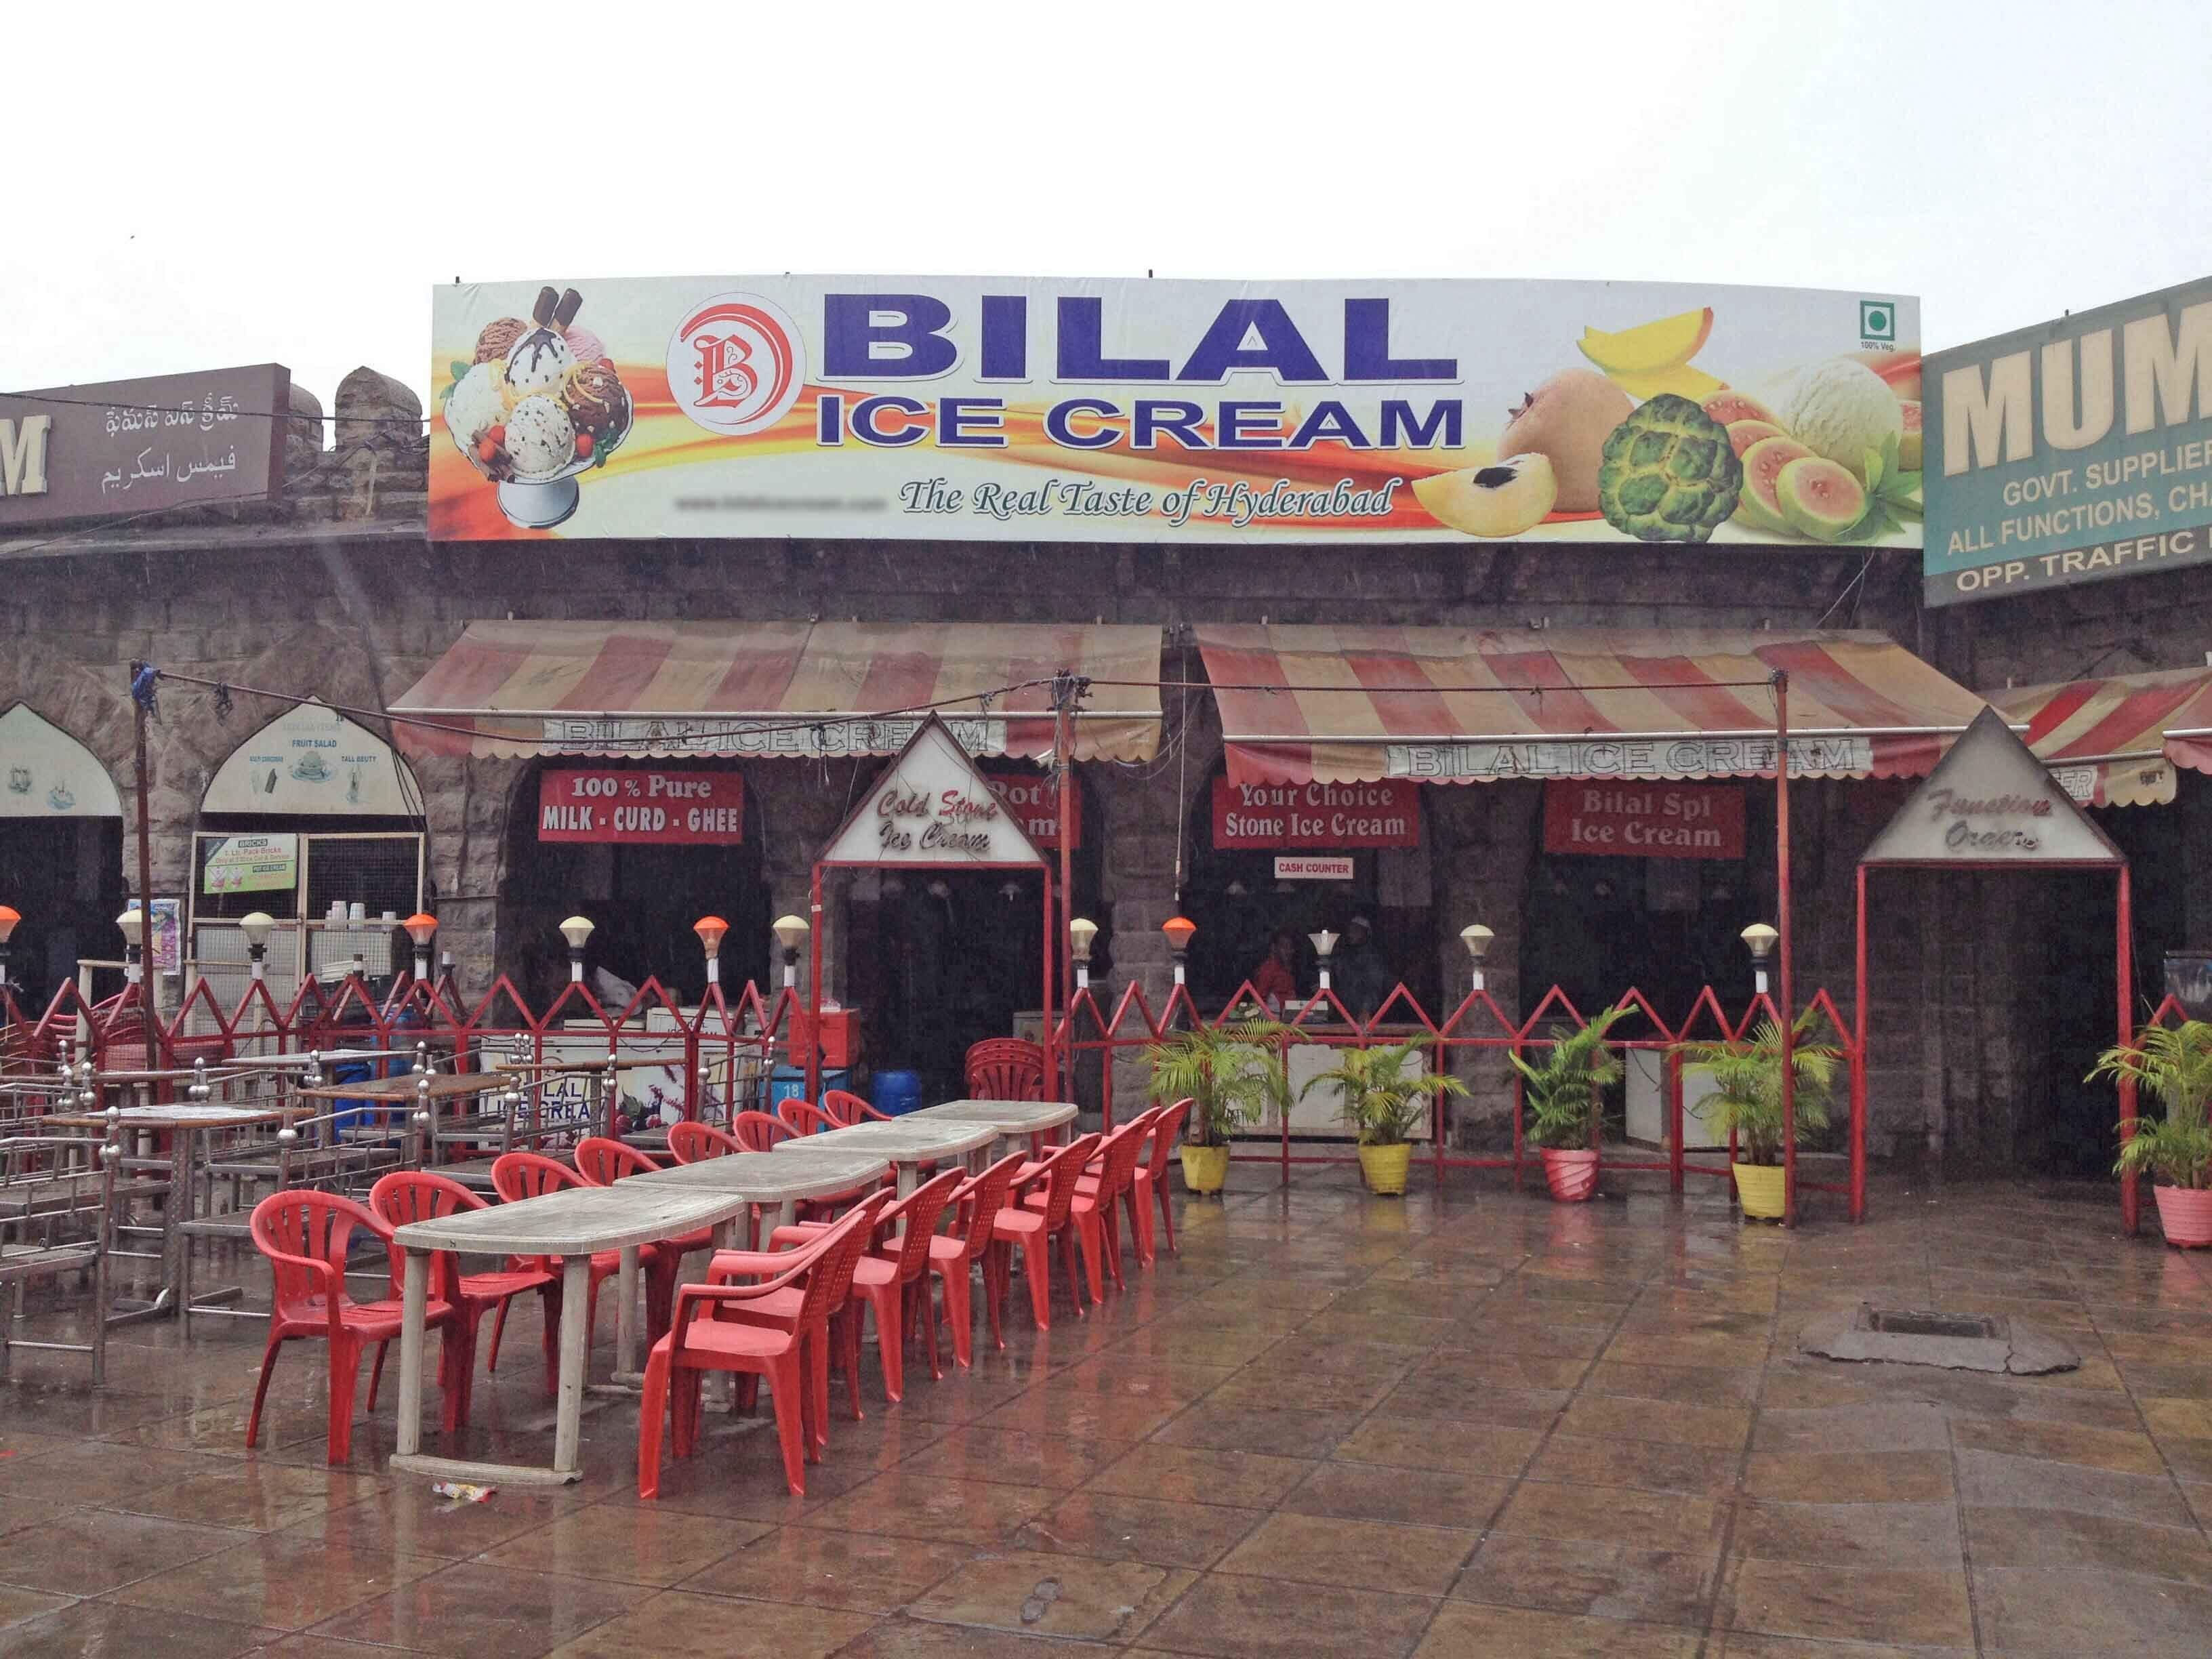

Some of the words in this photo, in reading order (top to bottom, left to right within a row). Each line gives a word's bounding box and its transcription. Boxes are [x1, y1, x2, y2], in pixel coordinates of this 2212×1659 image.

[824, 293, 1457, 382] BILAL
[821, 396, 1006, 447] ICE
[1047, 398, 1462, 447] CREAM
[901, 477, 962, 515] The
[974, 478, 1059, 521] Real
[1062, 478, 1151, 517] Taste
[1162, 478, 1202, 527] of
[1202, 477, 1402, 527] Hyderabad
[2003, 470, 2077, 507] GOVT.
[1947, 525, 1995, 556] ALL
[2001, 493, 2160, 545] FUNCTIONS,
[2169, 481, 2212, 512] CH
[1956, 560, 2030, 592] OPP.
[2039, 531, 2196, 577] TRAFFIC
[292, 739, 312, 748] FRUIT
[314, 739, 337, 748] SALAD
[716, 721, 800, 752] ICE
[811, 720, 989, 752] CREM
[1407, 745, 1559, 777] BILAL
[1569, 743, 1656, 775] ICE
[1666, 739, 1856, 773] CREAM
[571, 777, 618, 797] 100
[625, 781, 640, 797] %
[647, 775, 711, 798] Pure
[1240, 784, 1297, 806] Your
[1307, 784, 1393, 806] Choice
[542, 806, 592, 831] MILK
[613, 807, 665, 832] CURD
[687, 808, 738, 832] GHEE
[877, 790, 930, 817] Cold
[939, 789, 999, 821] Stone
[1582, 790, 1652, 813] Bilal
[1663, 792, 1711, 819] Spl
[879, 820, 912, 851] Ice
[919, 823, 990, 851] Cream
[1225, 813, 1284, 837] Stone
[1291, 814, 1323, 836] Ice
[1330, 814, 1405, 836] Cream
[1572, 819, 1615, 842] Ice
[1624, 820, 1721, 846] Cream
[1279, 863, 1303, 874] CASH
[1306, 863, 1349, 874] COUNTER
[783, 1084, 799, 1099] 18
[497, 1100, 529, 1118] IE
[539, 1101, 601, 1119] CREA
